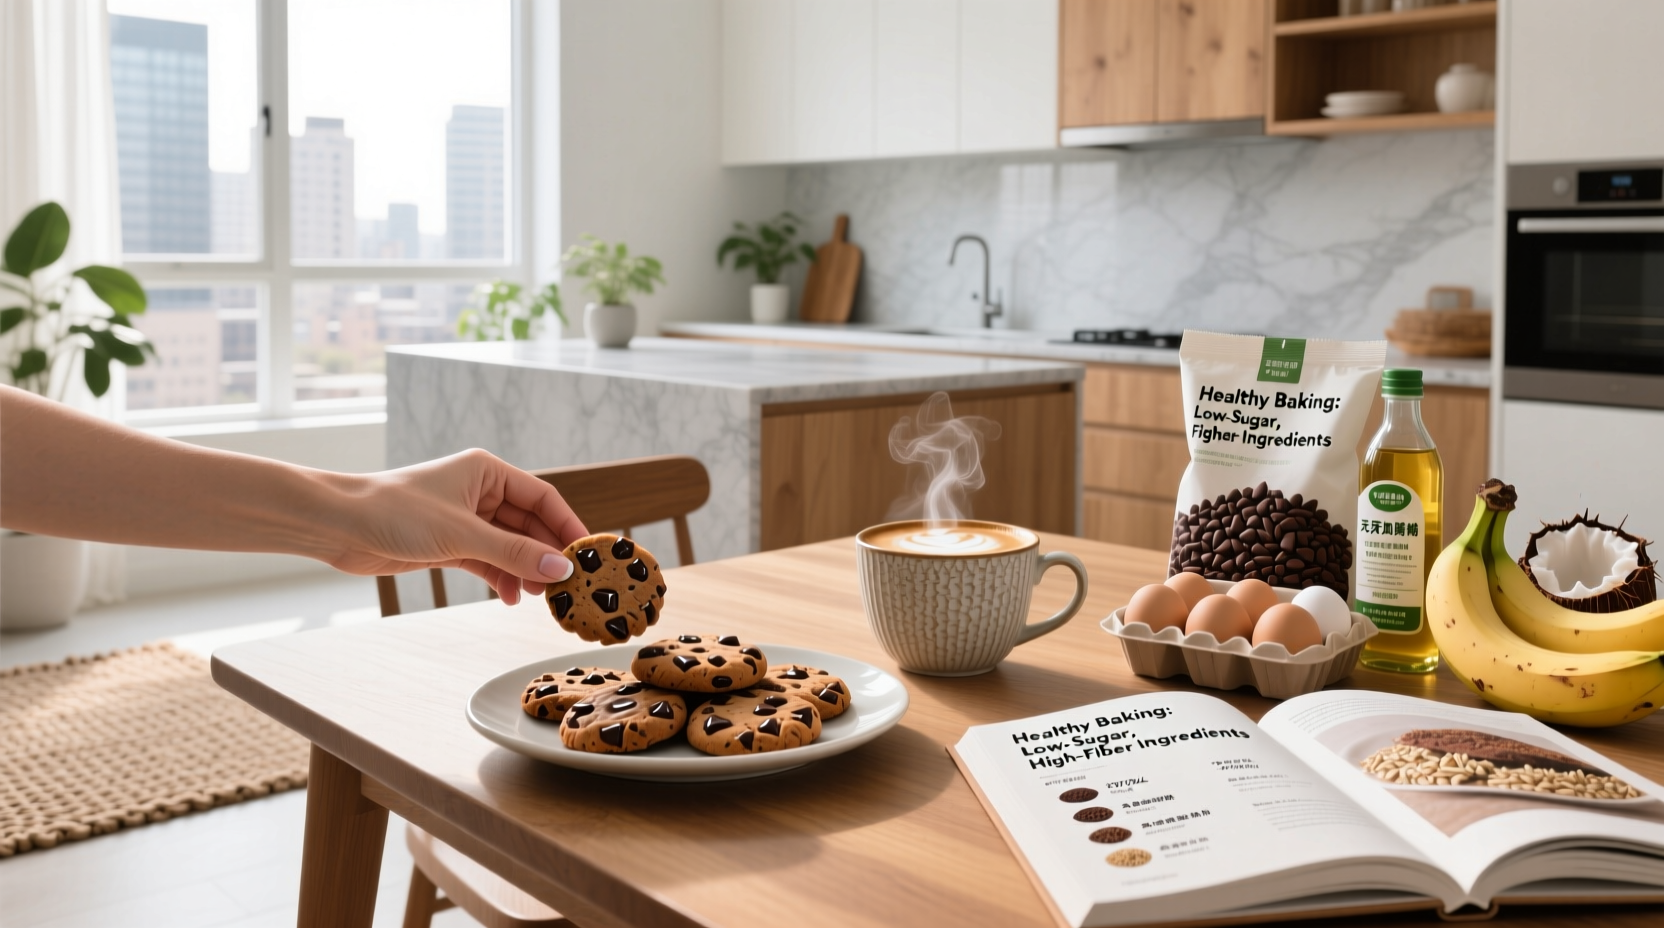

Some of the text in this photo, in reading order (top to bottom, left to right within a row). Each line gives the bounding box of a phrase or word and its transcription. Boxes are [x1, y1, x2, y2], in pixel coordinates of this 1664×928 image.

[1199, 385, 1341, 413] Healthy Baking:
[1194, 405, 1281, 430] Low-Sugar,
[1242, 430, 1332, 449] Ingredients
[1012, 707, 1173, 744] Healthy Baking:
[1021, 730, 1136, 756] Low-Sugar,
[1029, 728, 1250, 769] High-Fiber Ingredients
